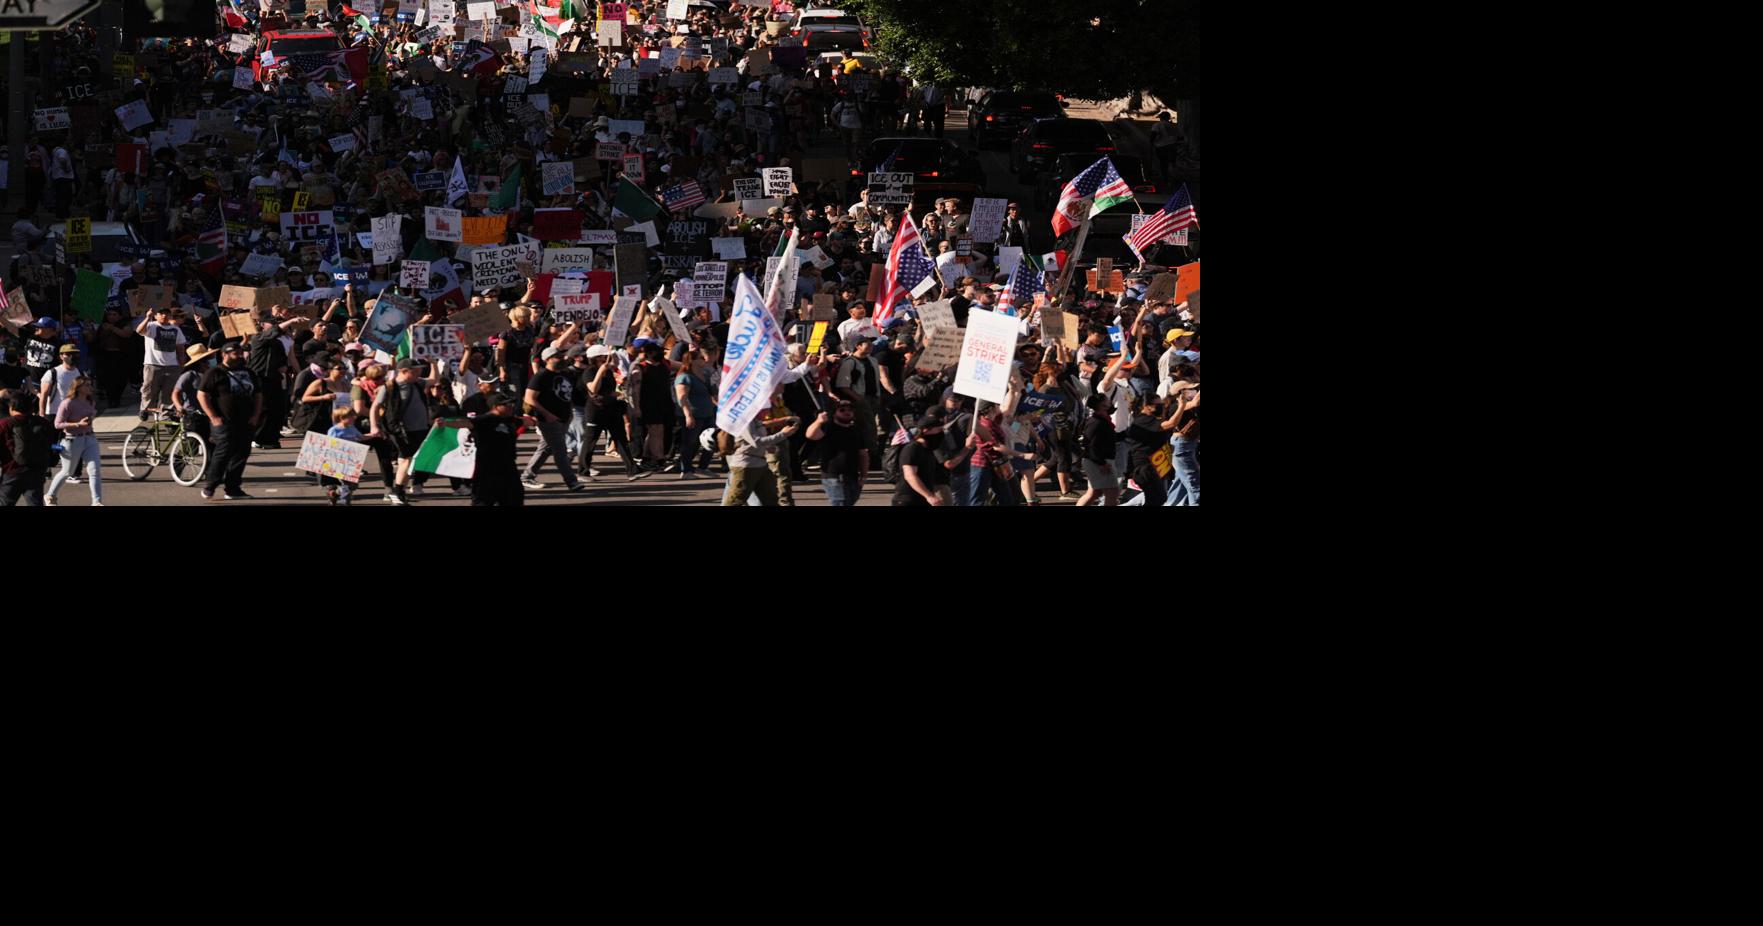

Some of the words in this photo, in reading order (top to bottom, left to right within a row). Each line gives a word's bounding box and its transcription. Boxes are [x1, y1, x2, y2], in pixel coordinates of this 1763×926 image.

[604, 5, 622, 14] NO
[67, 83, 96, 99] ICE
[871, 174, 888, 183] ICE
[891, 174, 912, 183] OUT
[294, 213, 319, 225] NO
[71, 219, 86, 234] ICE
[667, 221, 706, 234] ABOLISH
[287, 226, 331, 241] ICE
[672, 234, 697, 244] ICE
[475, 251, 502, 261] THE
[502, 245, 531, 257] ONLY
[552, 254, 590, 263] ABOLISH
[475, 258, 517, 270] VIOLENT
[475, 266, 516, 278] CRIMINA
[475, 277, 499, 288] NEED
[561, 295, 593, 305] TRUMP
[557, 310, 600, 323] PENDEJO
[414, 327, 459, 344] ICE
[413, 344, 459, 357] OUT
[969, 338, 1008, 355] GENERAL
[967, 346, 1006, 365] STRIKE
[1024, 396, 1045, 407] ICE
